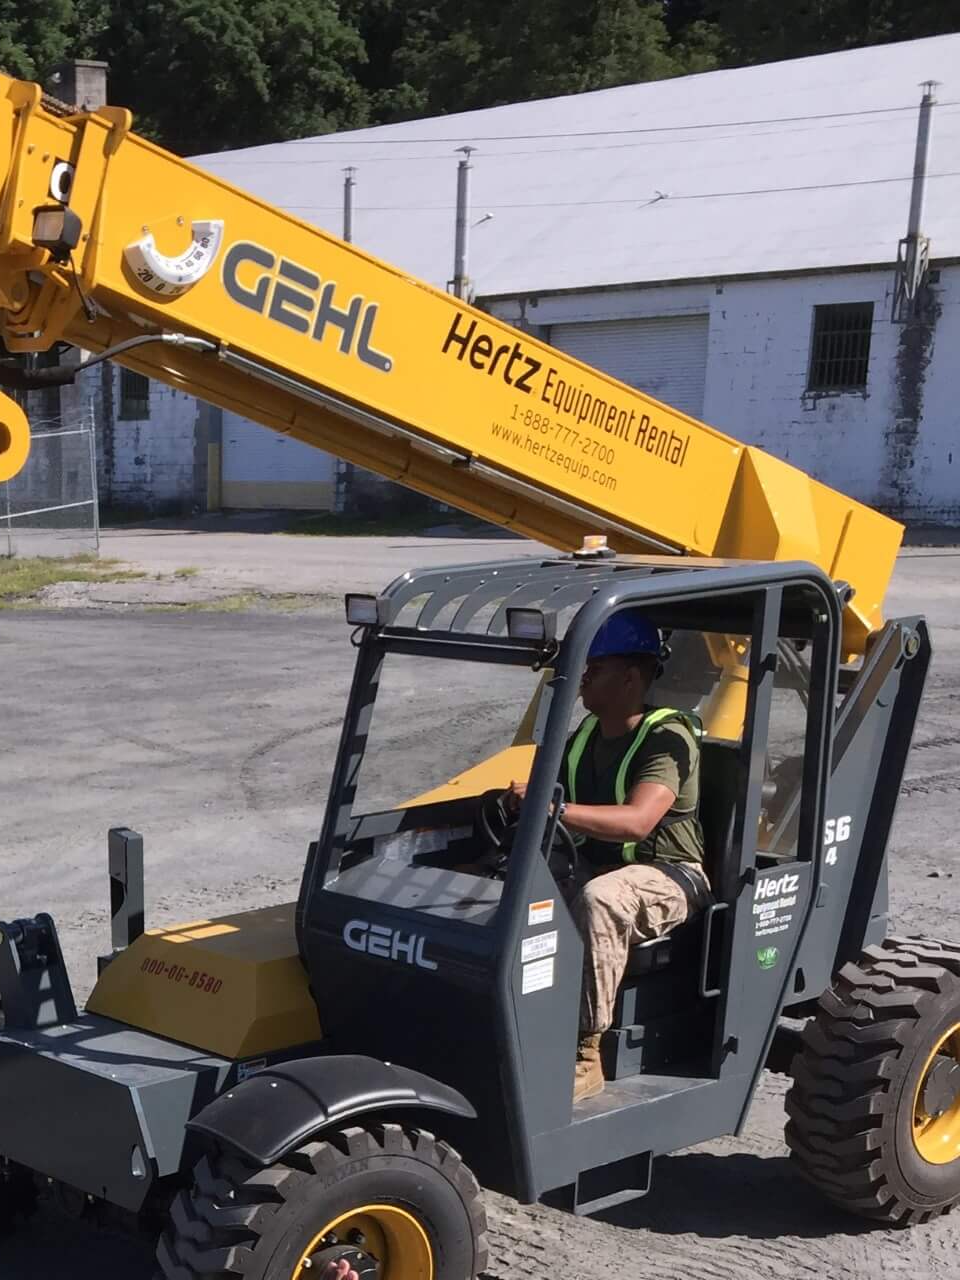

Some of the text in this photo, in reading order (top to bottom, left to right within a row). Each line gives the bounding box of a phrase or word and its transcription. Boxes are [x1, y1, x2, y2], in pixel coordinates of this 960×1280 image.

[222, 241, 393, 373] GEHL
[442, 312, 691, 468] Hertz Equipment Rental
[491, 421, 618, 491] www.hertzequip.com
[510, 404, 616, 466] 1-888-777-2700
[754, 873, 800, 900] Hertz
[343, 919, 438, 971] GEHL
